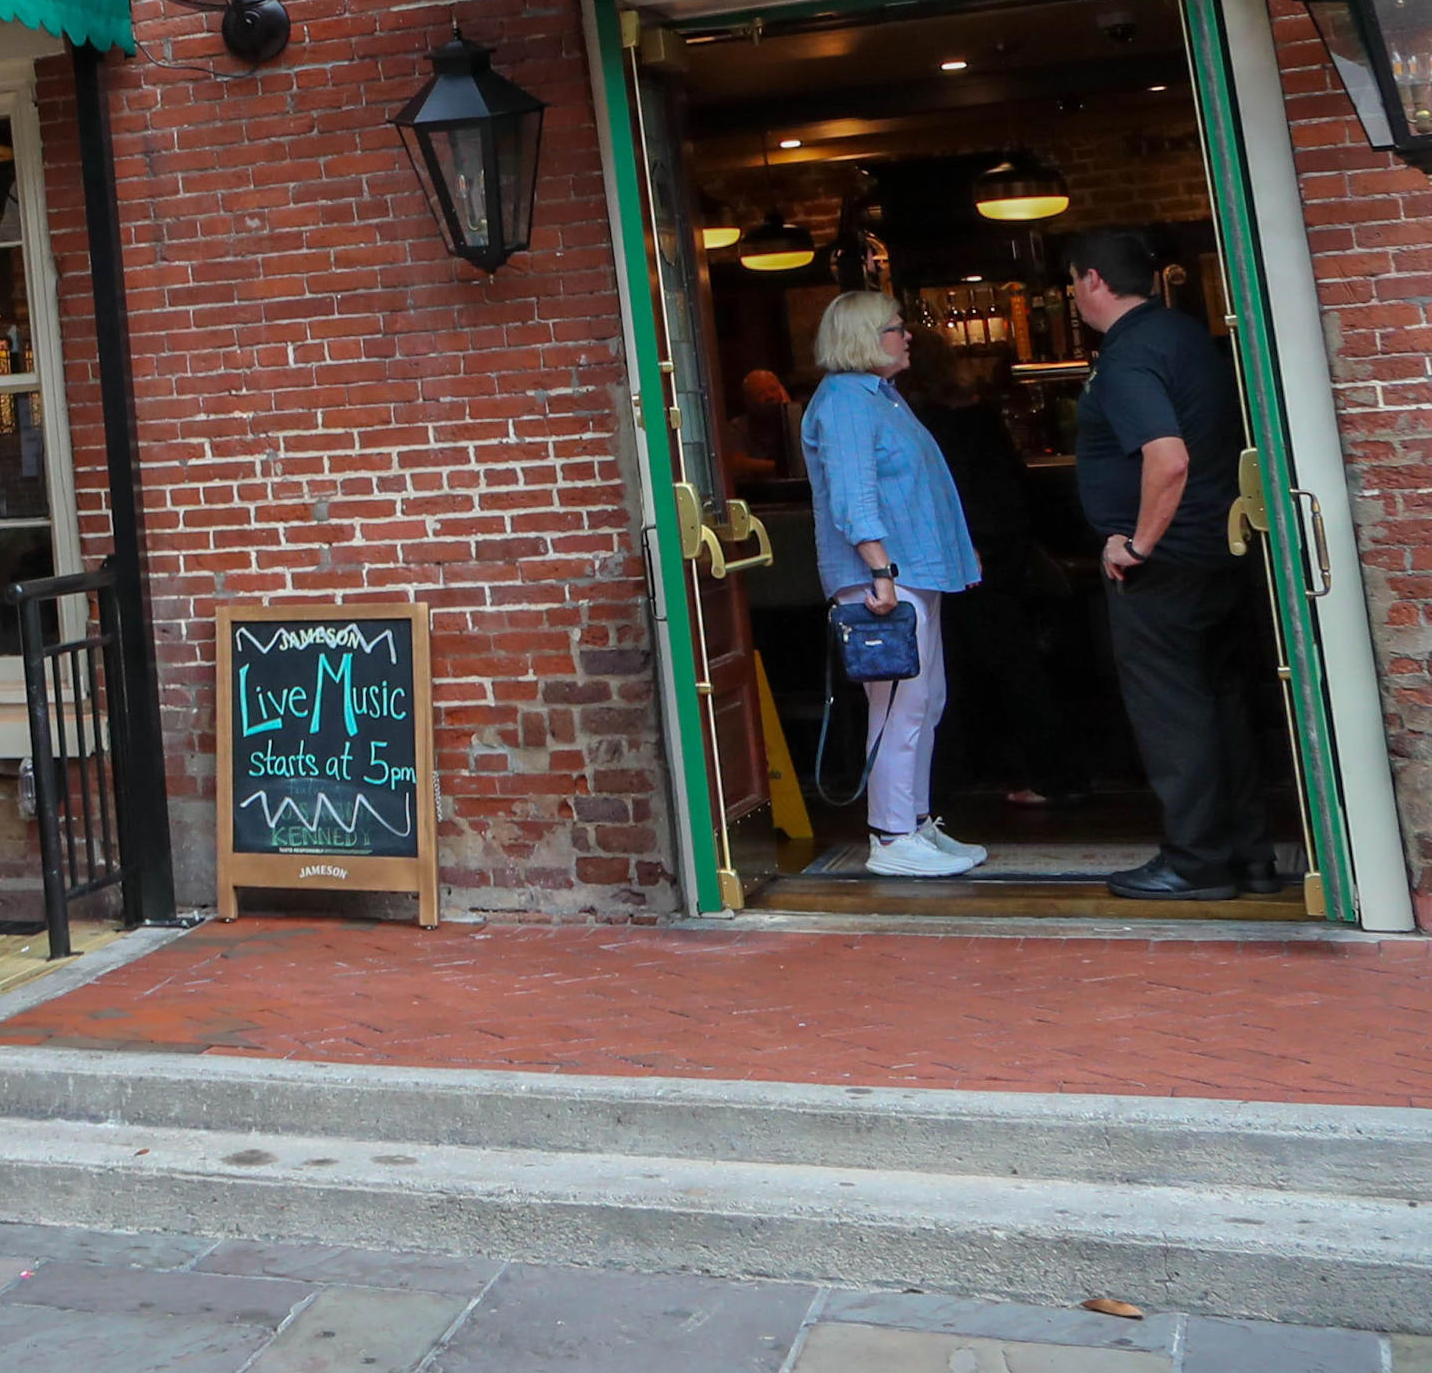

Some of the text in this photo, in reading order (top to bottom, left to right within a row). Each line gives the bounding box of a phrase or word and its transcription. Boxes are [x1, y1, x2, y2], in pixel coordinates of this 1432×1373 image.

[279, 628, 360, 651] JAMESON
[239, 653, 407, 737] Live Music
[248, 740, 319, 777] starts
[326, 741, 353, 780] at
[363, 741, 417, 790] 5pm
[272, 826, 371, 846] KENNEDY
[299, 864, 347, 879] JAMESON
